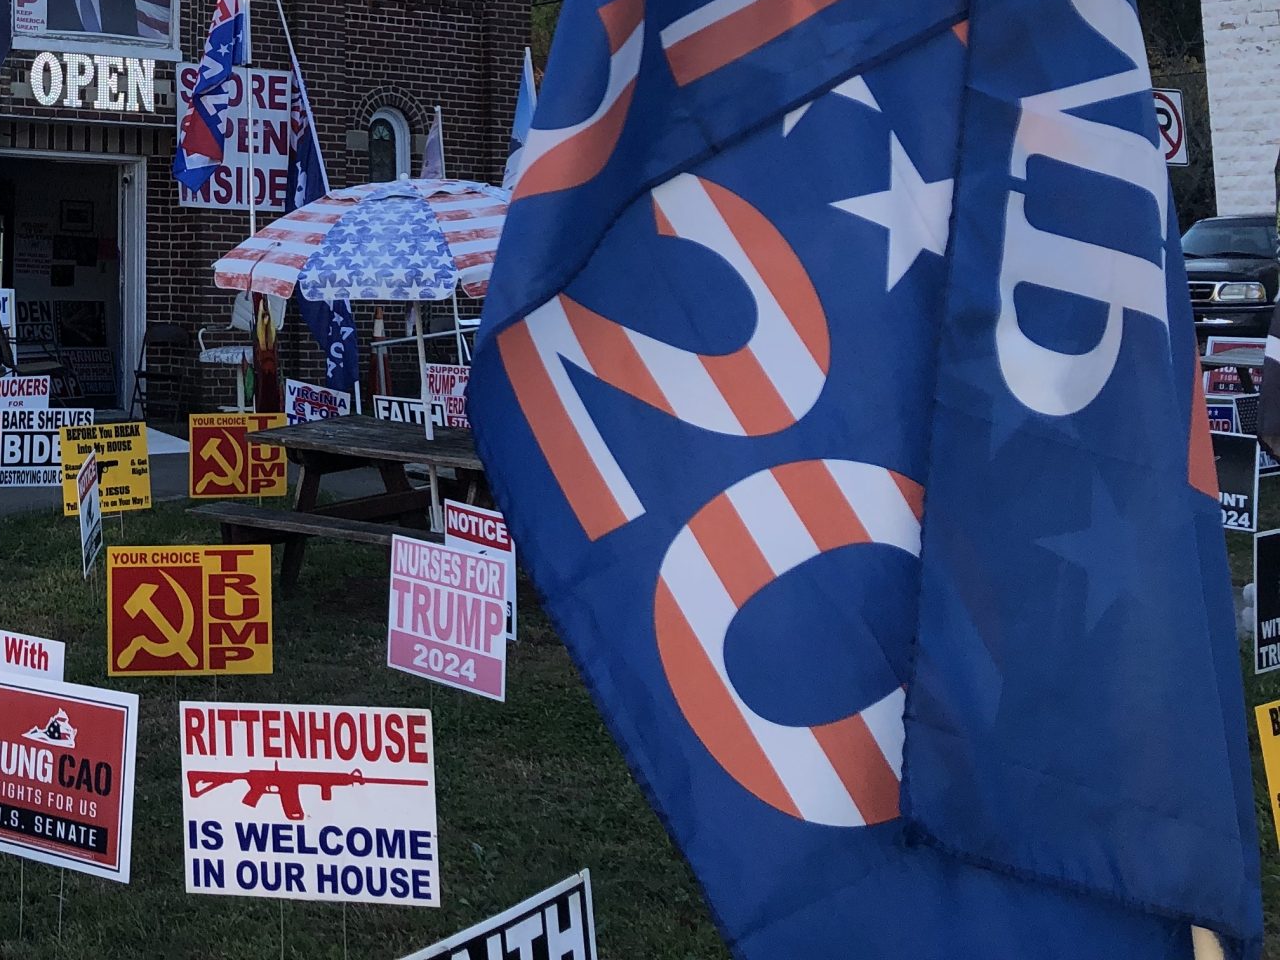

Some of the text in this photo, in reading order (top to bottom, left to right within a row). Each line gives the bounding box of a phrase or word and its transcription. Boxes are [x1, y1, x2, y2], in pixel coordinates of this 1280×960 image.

[30, 52, 155, 112] OPEN
[180, 68, 288, 112] SORE
[17, 301, 51, 323] DEN
[288, 385, 347, 409] VIRGINIA
[427, 374, 455, 395] RUMP
[293, 401, 305, 412] IS
[377, 400, 442, 426] FAITH
[2, 411, 34, 429] BARE
[38, 411, 92, 430] SHELVES
[66, 425, 140, 440] BEFORE You BREAK
[192, 417, 246, 425] YOUR CHOICE
[3, 435, 61, 463] BIDE
[77, 440, 132, 455] Into My HOUSE
[248, 415, 284, 493] TUMP
[0, 470, 40, 484] DESTROYING
[43, 470, 56, 483] OUR
[132, 468, 148, 476] Right
[66, 503, 77, 511] Tell
[132, 497, 143, 505] Way
[106, 486, 130, 496] JESUS
[448, 509, 508, 544] NOTICE
[112, 551, 200, 564] YOUR CHOICE
[396, 541, 501, 597] NURSES FOR
[204, 550, 268, 670] TRUMP
[393, 578, 504, 653] TRUMP
[4, 636, 48, 672] With
[413, 643, 477, 682] 2024
[184, 707, 429, 764] RITTENHOUSE
[58, 754, 112, 796] CAO
[48, 792, 73, 812] FOR
[80, 799, 97, 818] US
[34, 816, 97, 848] SENATE
[187, 820, 433, 861] IS WELCOME
[192, 858, 432, 900] IN OUR HOUSE
